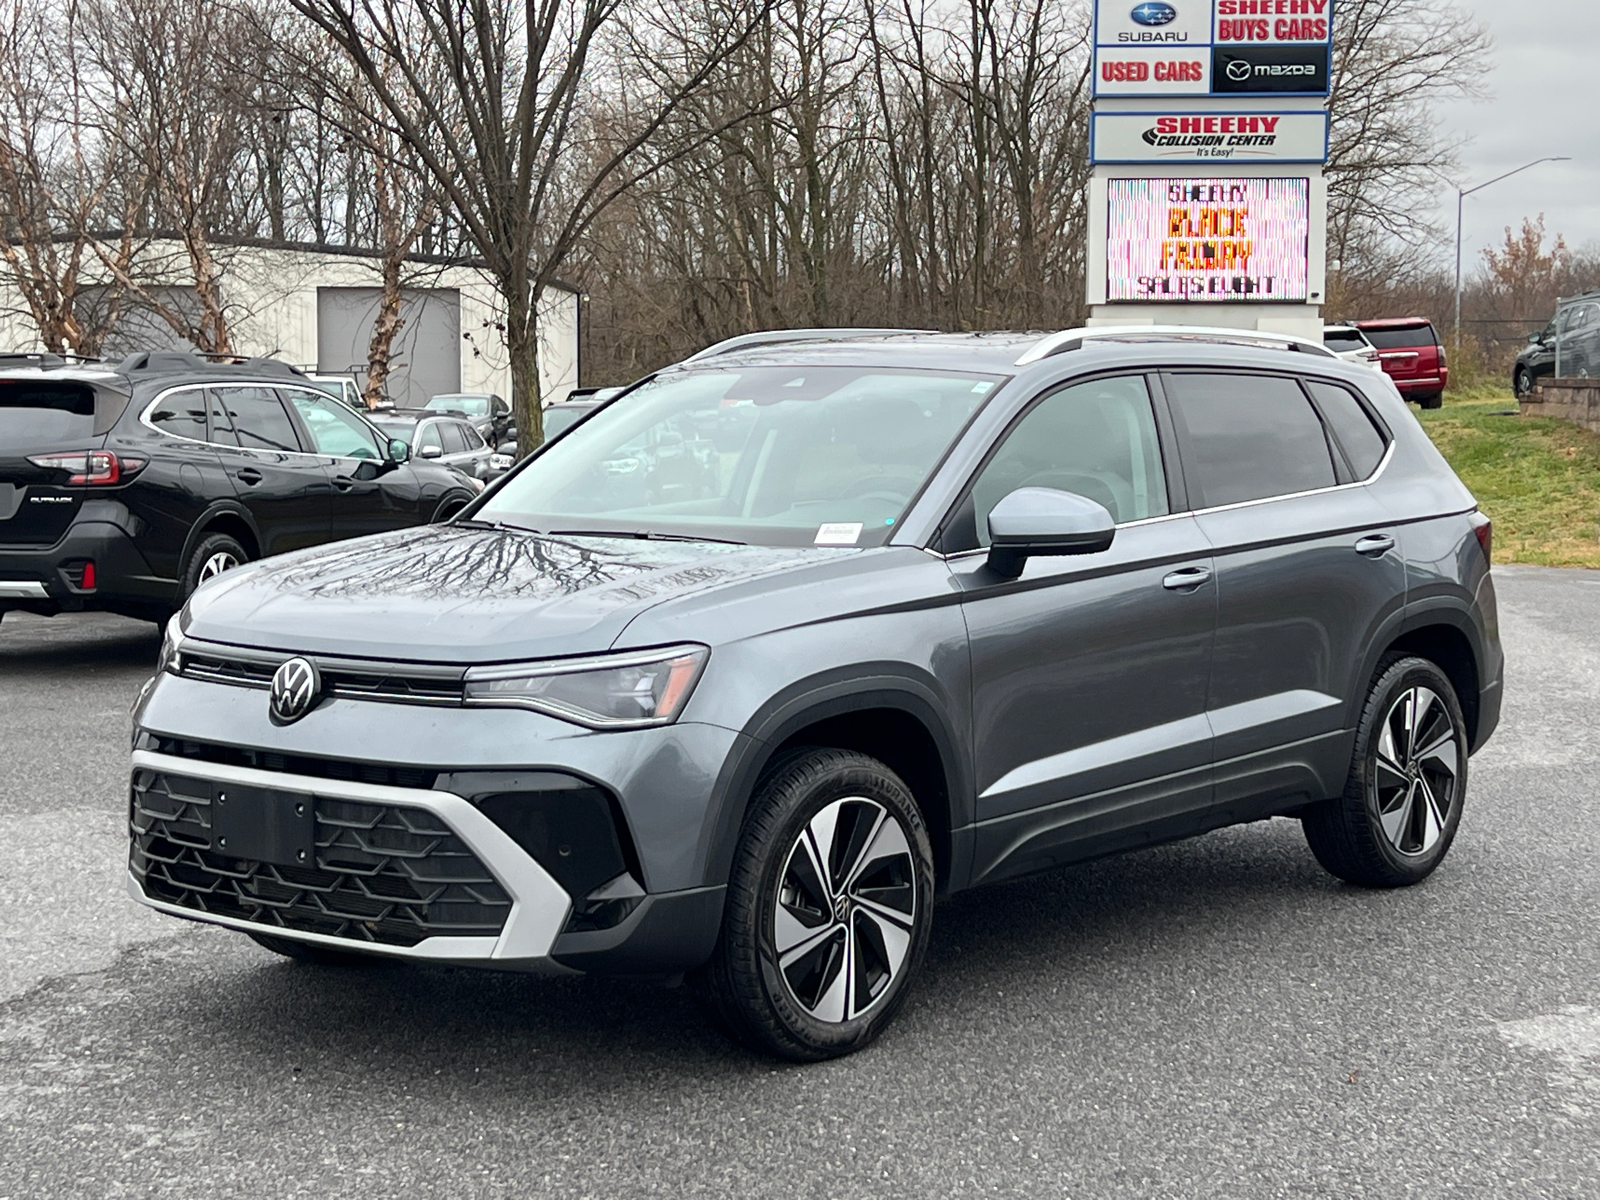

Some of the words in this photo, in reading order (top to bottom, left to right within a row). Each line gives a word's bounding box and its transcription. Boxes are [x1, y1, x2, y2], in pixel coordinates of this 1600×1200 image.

[1218, 0, 1327, 15] SHEEHY
[1118, 31, 1188, 42] SUBARU
[1218, 18, 1269, 41] BUYS
[1274, 18, 1328, 41] CARS
[1102, 61, 1149, 82] USED
[1153, 61, 1203, 82] CARS
[1254, 64, 1316, 76] mazda
[1156, 116, 1280, 134] SHEEHY
[1156, 135, 1225, 147] COLLISION
[1226, 134, 1277, 146] CENTER
[1196, 148, 1209, 157] It's
[1211, 147, 1234, 158] Easy!
[1168, 207, 1249, 238] BLACK
[1160, 240, 1253, 270] FRIDAY
